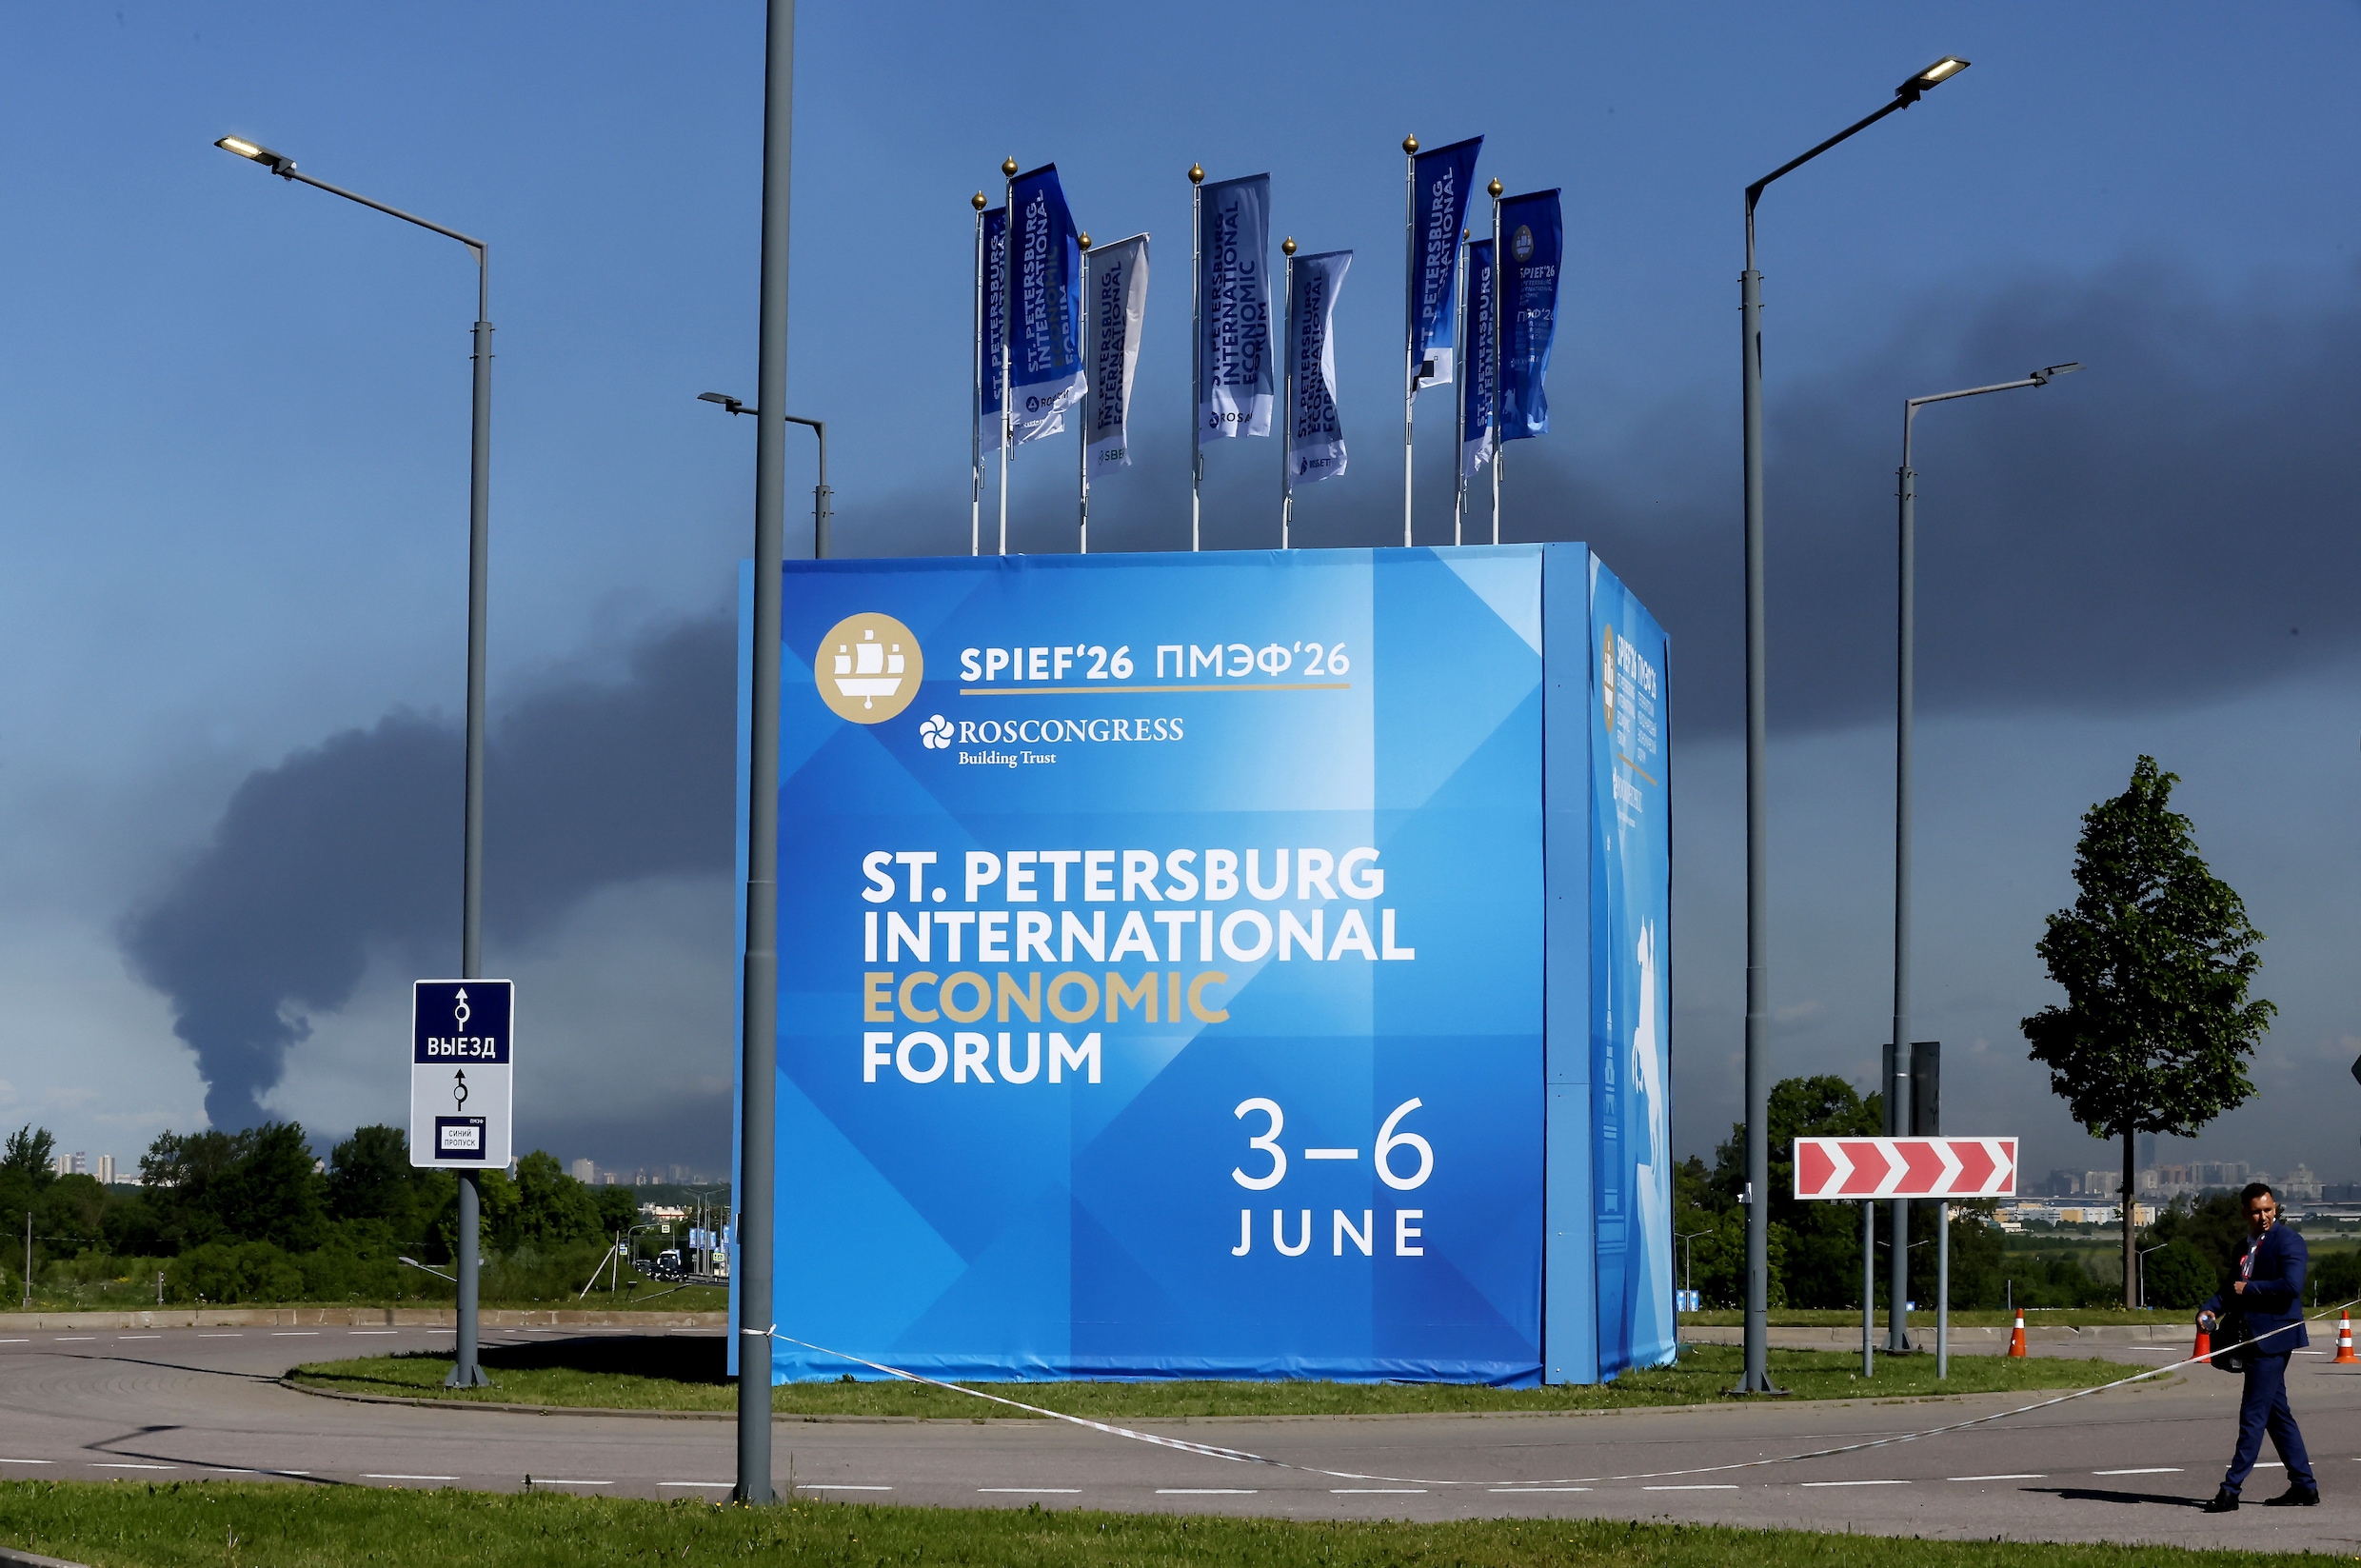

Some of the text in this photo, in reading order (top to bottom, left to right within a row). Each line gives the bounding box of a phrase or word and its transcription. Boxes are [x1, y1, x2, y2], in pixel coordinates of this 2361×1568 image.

[990, 234, 1002, 367] PETERSBURG
[1023, 203, 1039, 373] ST. PETERSBURG
[1035, 189, 1051, 369] INTERNATIONAL
[1045, 246, 1064, 367] ECONOMIC
[1222, 201, 1240, 386] INTERNATIONAL
[1422, 180, 1443, 318] PETERSBURG
[1098, 272, 1112, 398] PETERSBURG
[1103, 261, 1121, 427] INTERNATIONAL
[1240, 260, 1258, 385] ECONOMIC
[1300, 282, 1313, 407] PETERSBURG
[1477, 266, 1491, 396] PETERSBURG
[958, 750, 1057, 768] Building Trust
[959, 718, 1184, 745] ROSCONGRESS
[861, 847, 1385, 903] ST. PETERSBURG
[863, 908, 1416, 963] INTERNATIONAL
[427, 1037, 496, 1059] ВЫЕЗД
[863, 970, 1230, 1023] ECONOMIC
[863, 1031, 1101, 1084] FORUM
[444, 1139, 476, 1147] ПРОПУСК
[448, 1129, 472, 1138] СИНИЙ
[1231, 1209, 1424, 1257] JUNE
